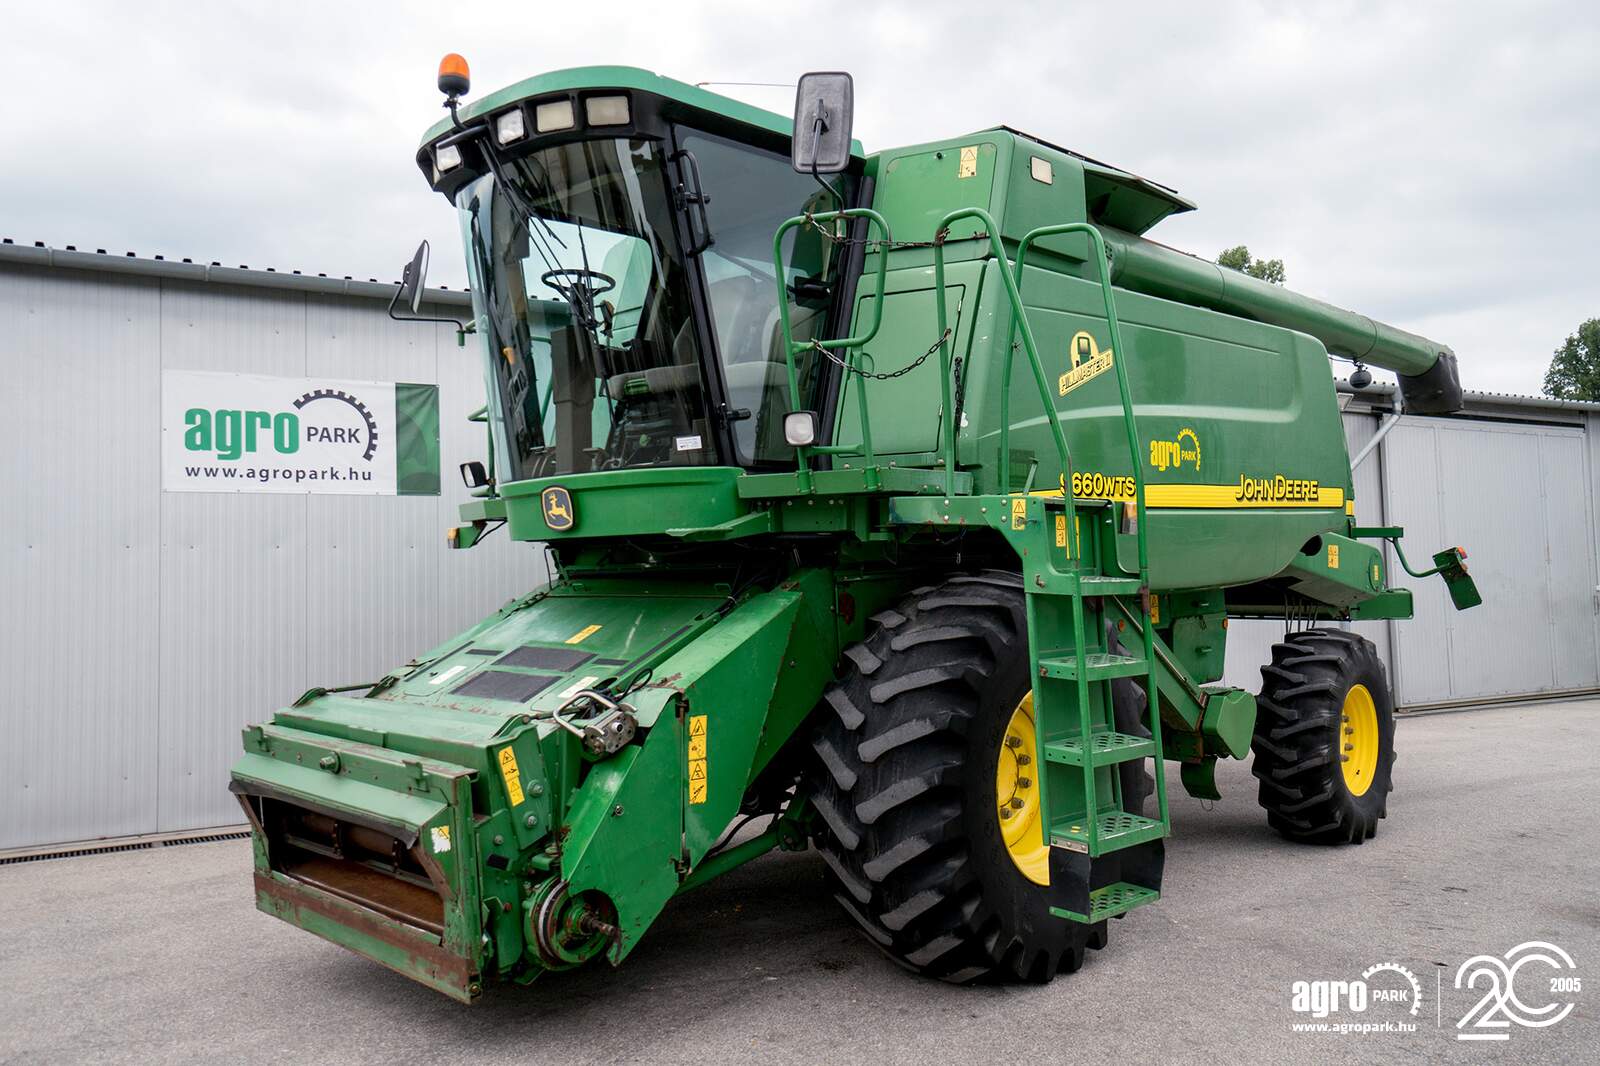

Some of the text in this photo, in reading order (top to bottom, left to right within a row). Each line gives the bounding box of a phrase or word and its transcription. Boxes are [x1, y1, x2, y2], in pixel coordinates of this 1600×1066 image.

[184, 407, 360, 460] agro PARK
[1150, 440, 1197, 471] agro PARK
[185, 466, 372, 482] www.agropark.hu
